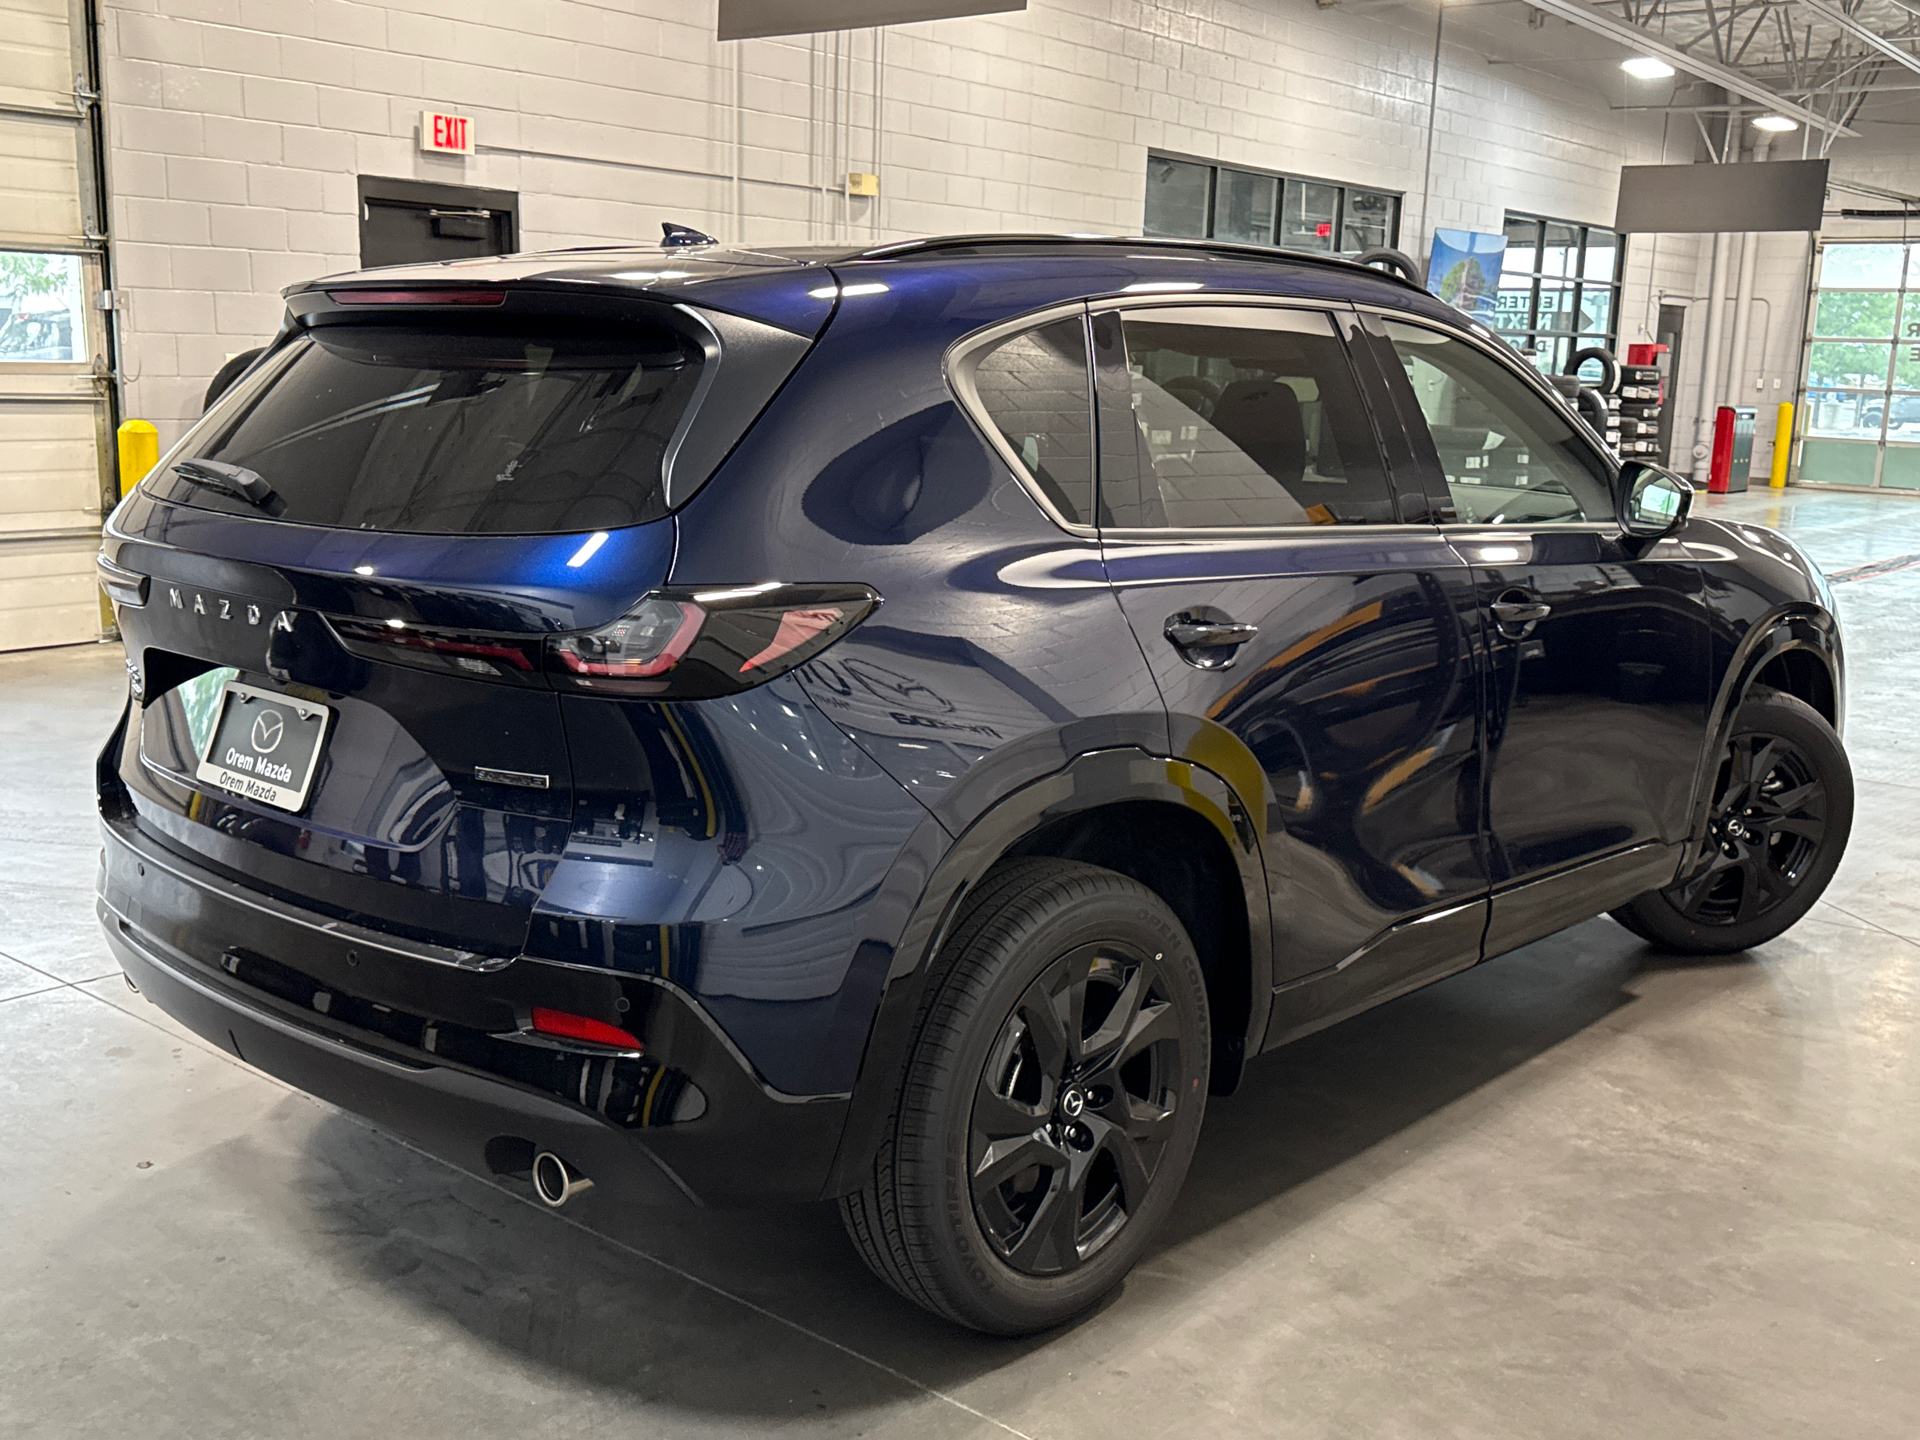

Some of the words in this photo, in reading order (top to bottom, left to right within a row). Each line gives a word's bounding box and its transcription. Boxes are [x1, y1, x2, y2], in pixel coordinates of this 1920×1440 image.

[433, 114, 467, 151] EXIT
[169, 587, 294, 633] MAZDA
[225, 747, 254, 772] Orem
[254, 756, 292, 783] Mazda
[219, 771, 244, 790] Orem
[244, 780, 277, 802] Mazda
[1136, 907, 1183, 950] OPEN
[955, 1235, 995, 1292] TOYO
